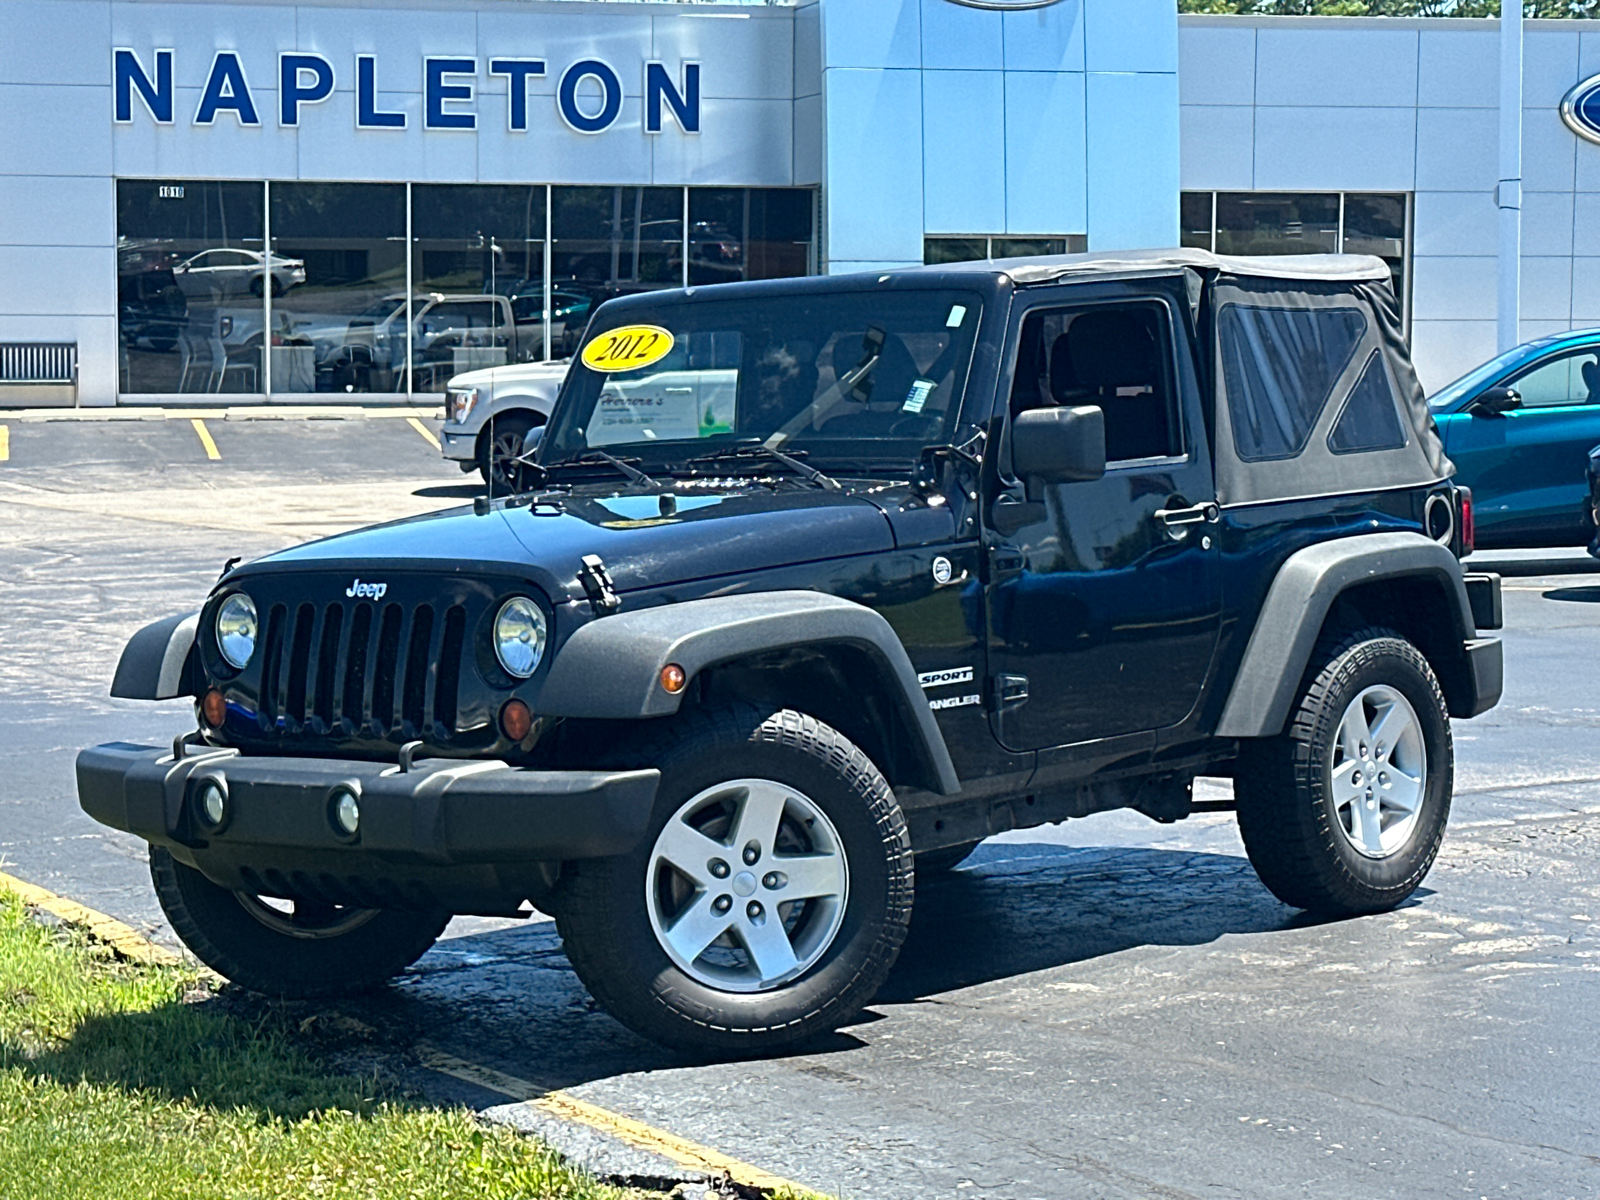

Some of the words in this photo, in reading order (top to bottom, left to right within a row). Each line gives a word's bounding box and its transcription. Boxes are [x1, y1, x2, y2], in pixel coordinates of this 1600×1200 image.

[112, 47, 702, 134] NAPLETON
[593, 333, 659, 362] 2012
[345, 578, 388, 601] Jeep
[921, 670, 969, 684] SPORT
[929, 694, 981, 709] ANGLER
